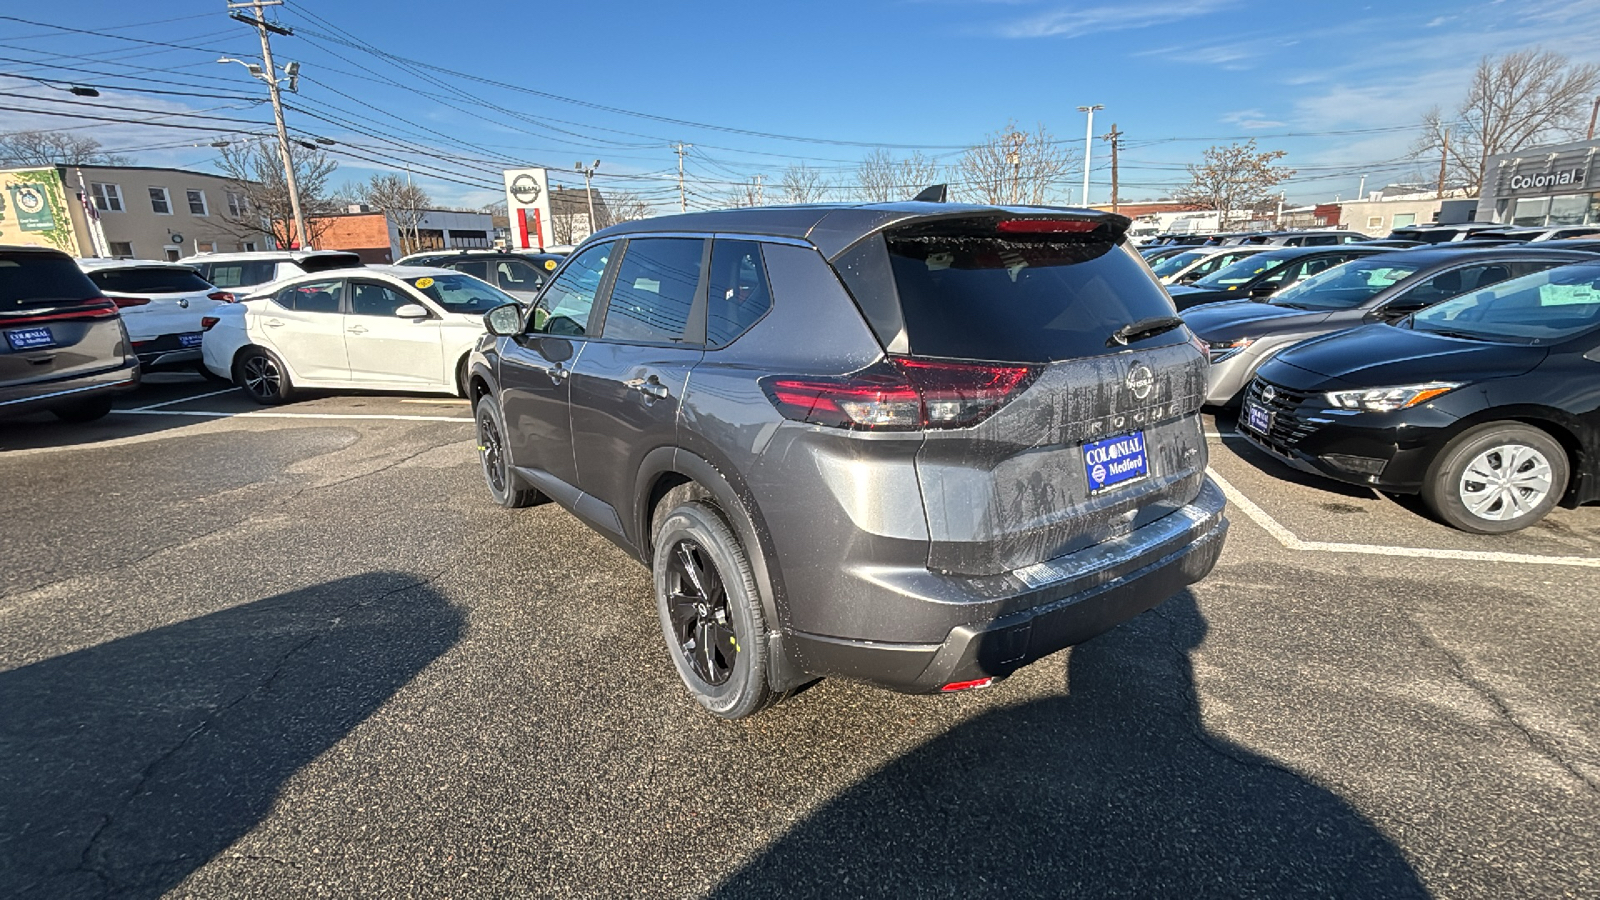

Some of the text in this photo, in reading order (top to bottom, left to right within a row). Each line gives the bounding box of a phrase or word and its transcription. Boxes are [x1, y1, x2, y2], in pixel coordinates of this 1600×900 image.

[1511, 168, 1576, 189] Colonial
[1092, 403, 1181, 433] ROGUE
[1086, 437, 1143, 466] COLONIAL
[1108, 454, 1143, 477] Medford
